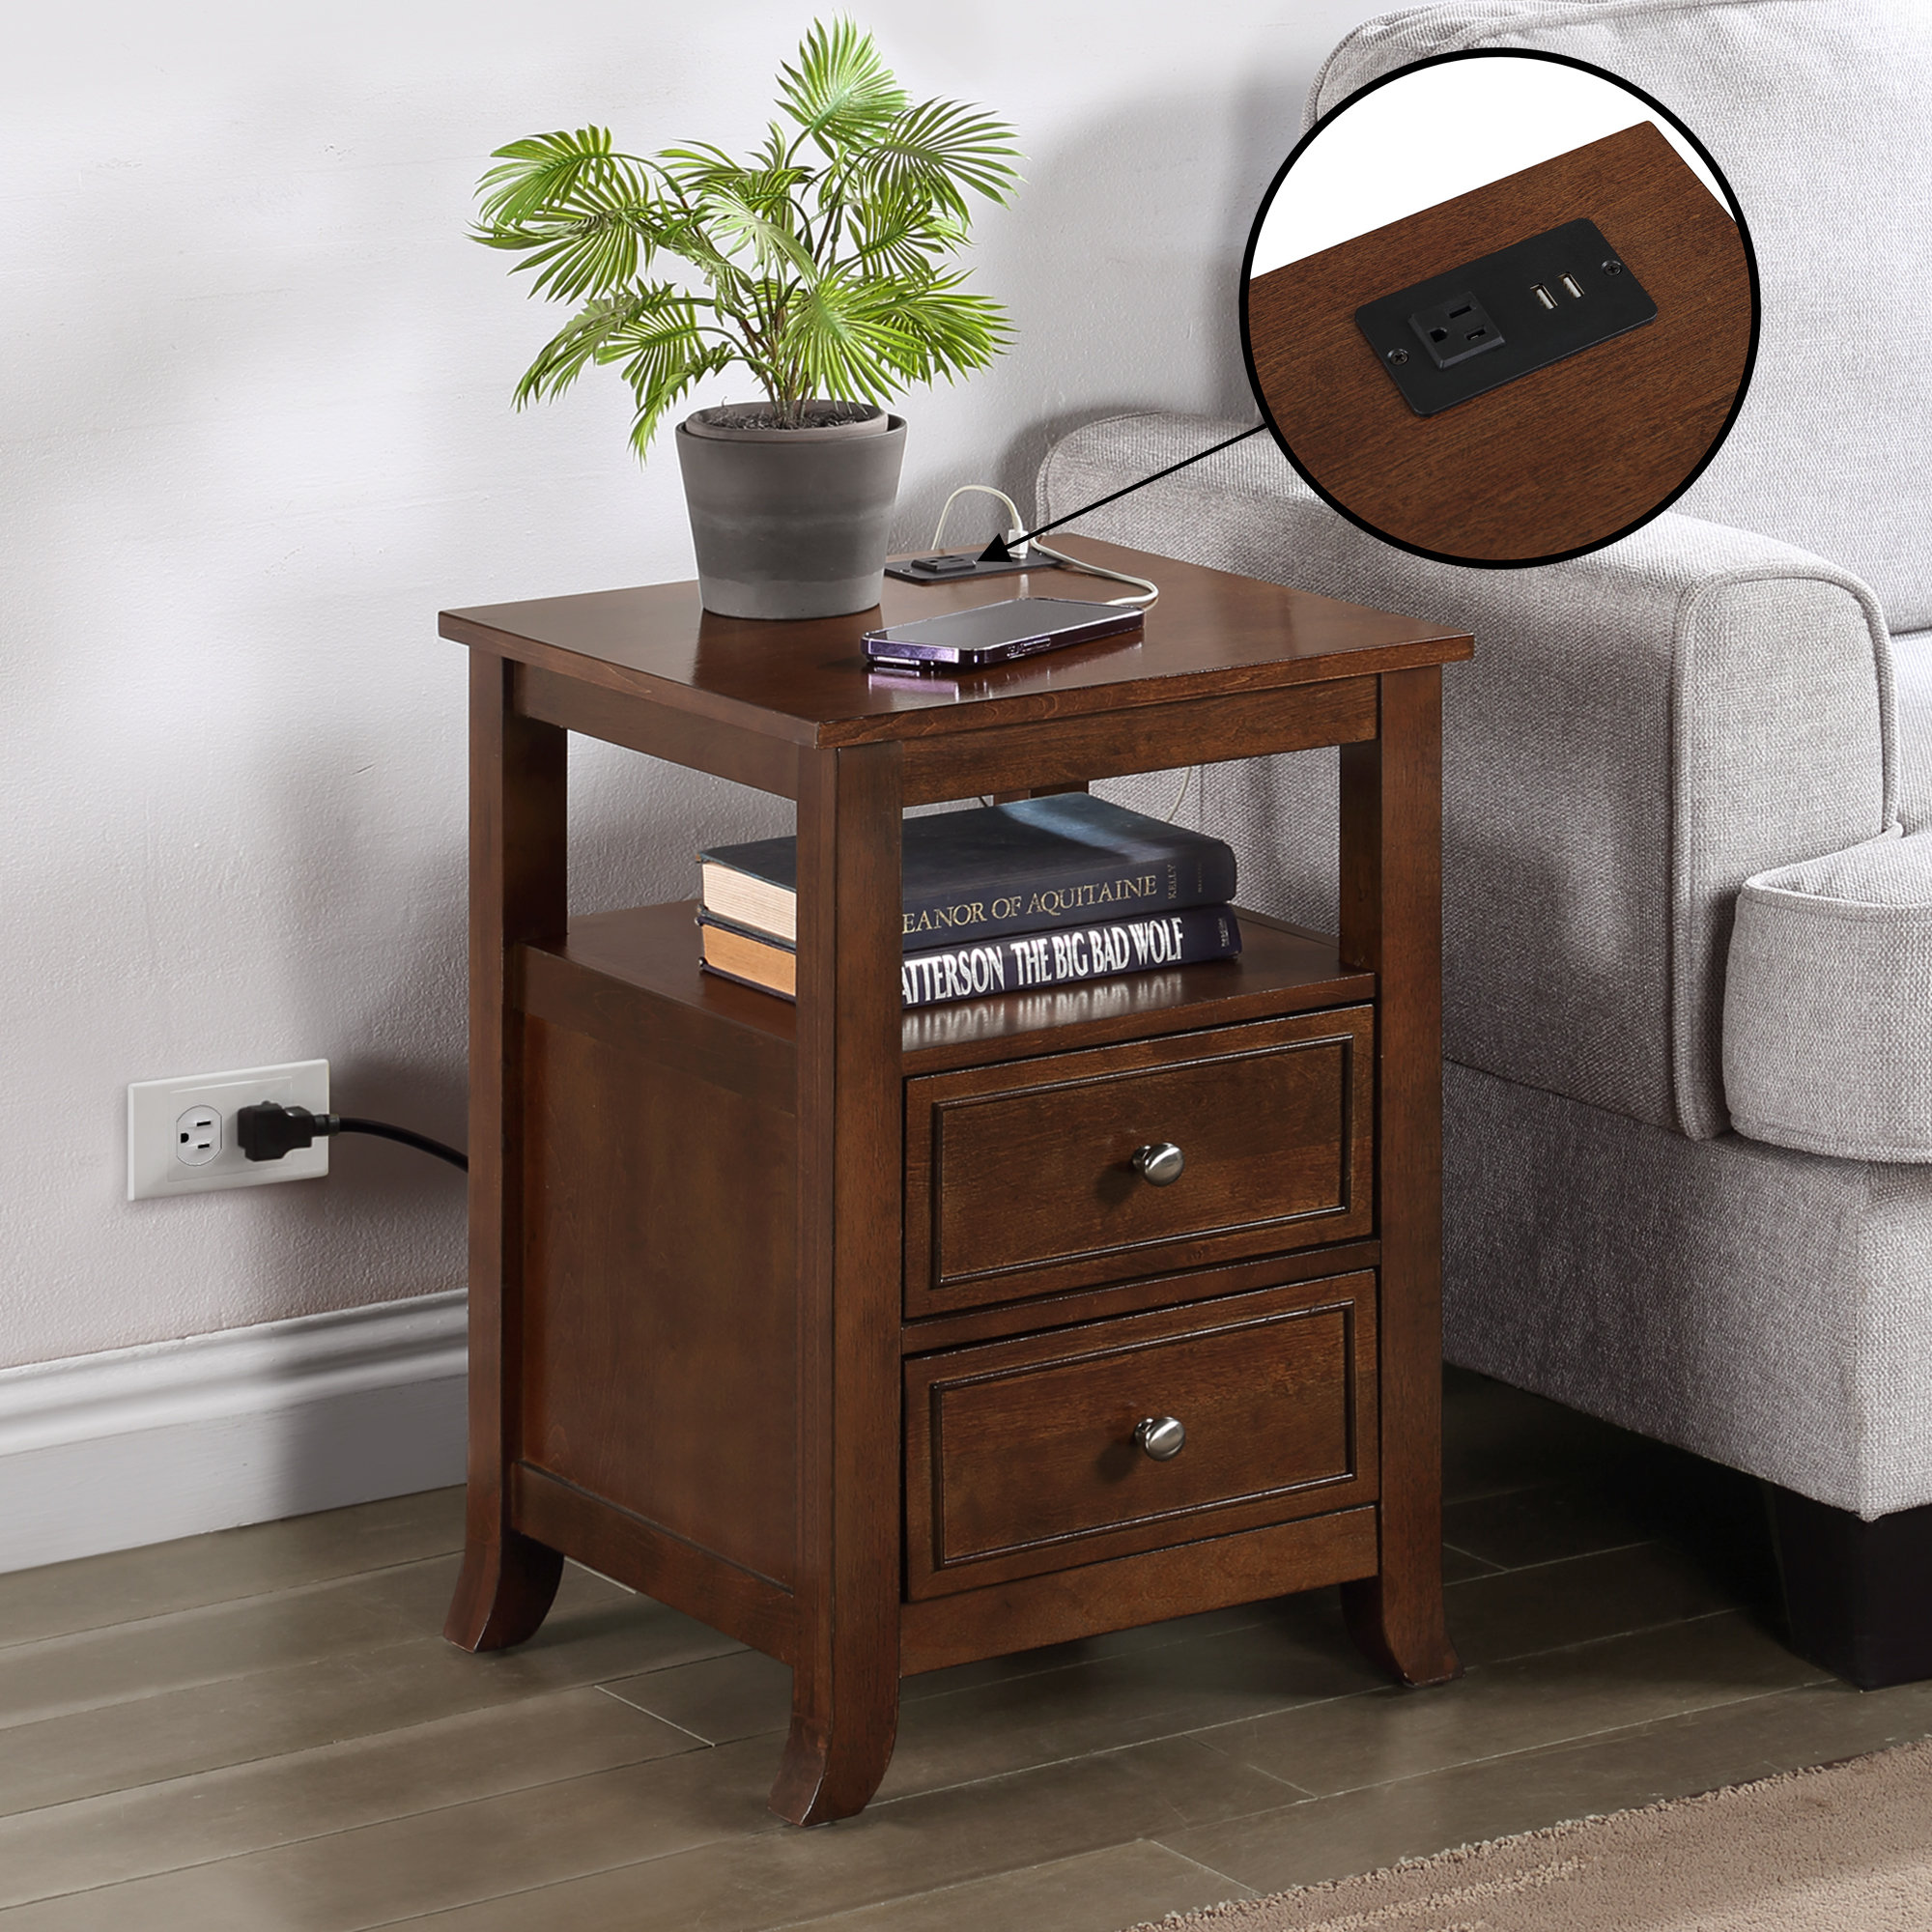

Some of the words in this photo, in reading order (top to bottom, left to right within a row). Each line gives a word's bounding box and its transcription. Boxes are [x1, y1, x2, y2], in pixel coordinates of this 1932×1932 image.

[991, 895, 1022, 920] OF
[1026, 874, 1158, 916] AQUITAINE
[1167, 865, 1178, 900] KELLY
[1009, 938, 1052, 985] THE
[1052, 930, 1089, 979] BIG
[1088, 925, 1130, 974] BAD
[1127, 917, 1183, 965] WOLF
